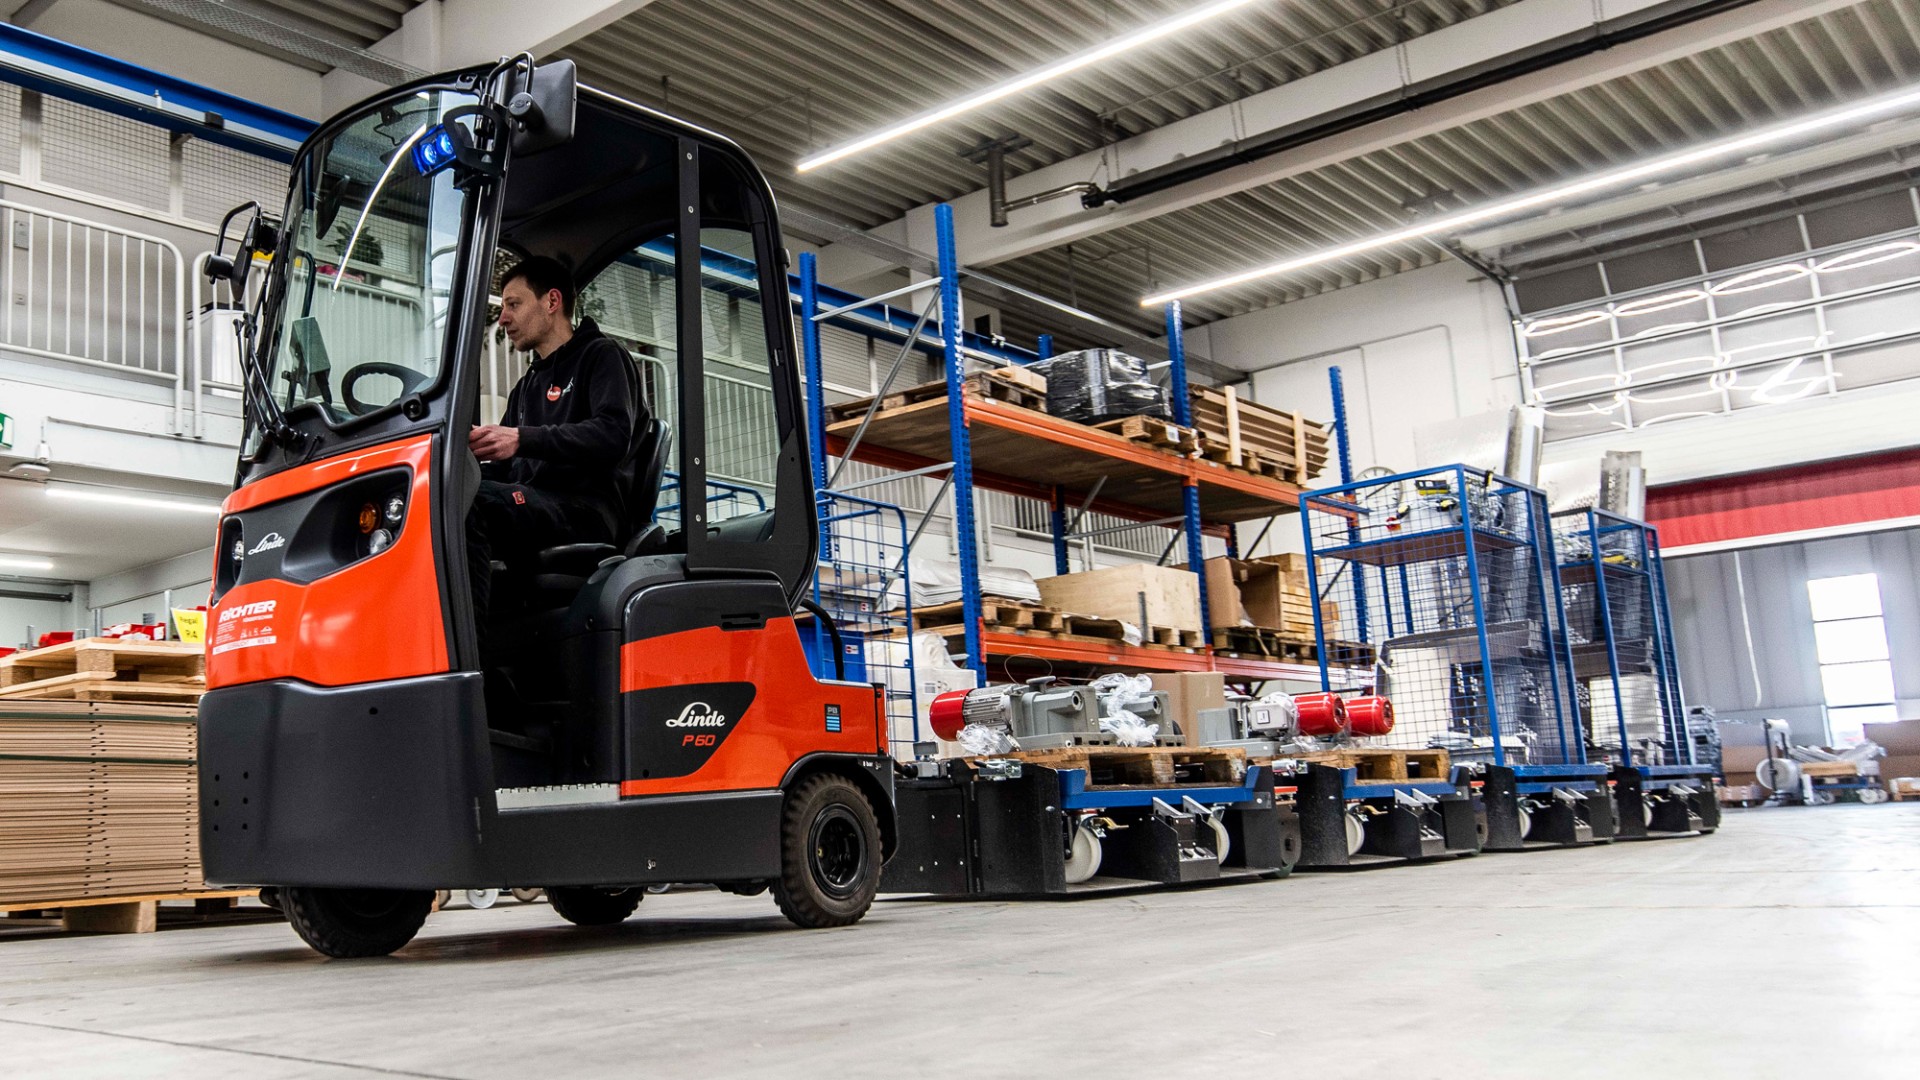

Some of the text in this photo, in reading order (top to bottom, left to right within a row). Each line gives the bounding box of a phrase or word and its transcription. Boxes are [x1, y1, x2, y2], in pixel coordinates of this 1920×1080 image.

[248, 532, 285, 555] Linde
[665, 701, 726, 727] Linde
[682, 735, 716, 747] P 60
